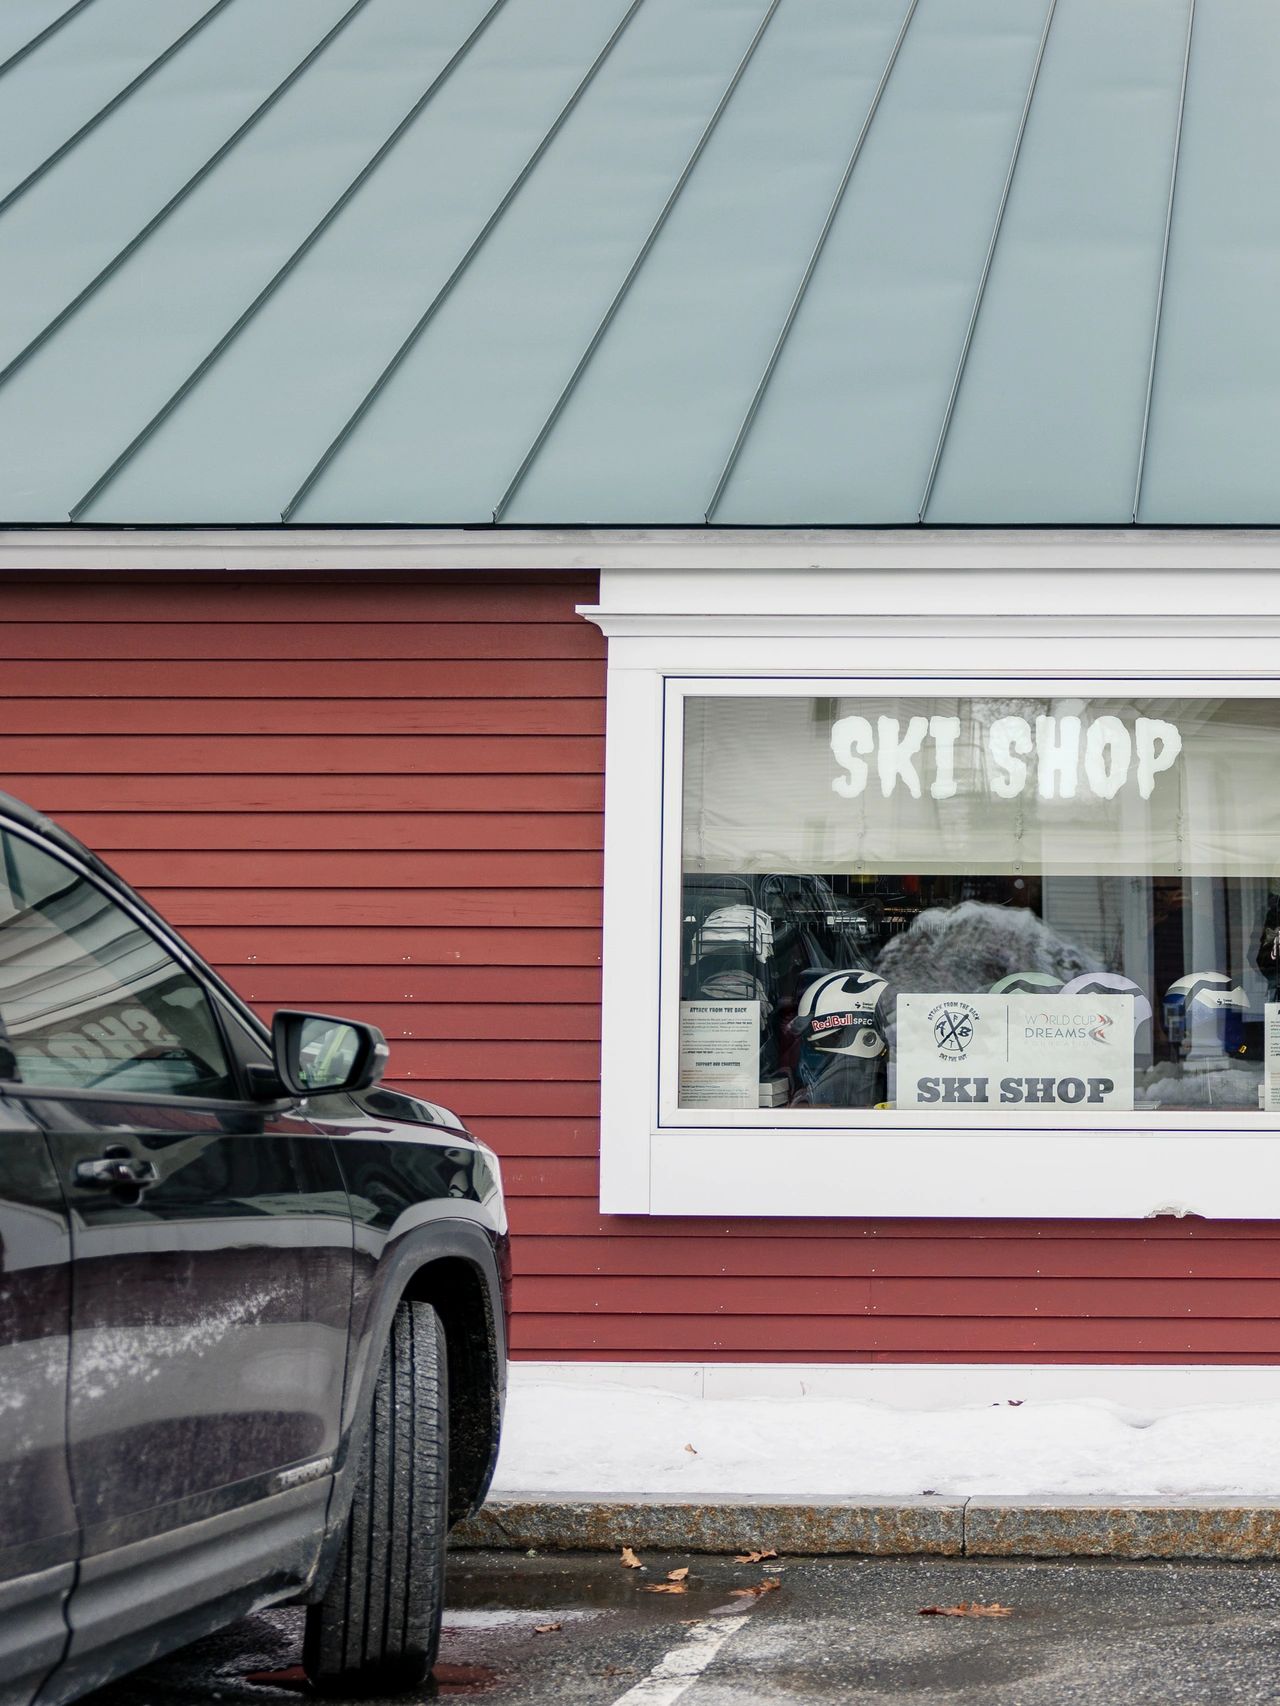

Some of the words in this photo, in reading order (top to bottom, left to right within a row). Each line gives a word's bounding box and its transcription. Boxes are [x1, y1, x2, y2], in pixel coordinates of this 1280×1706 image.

[830, 715, 961, 800] SKI
[988, 714, 1183, 800] SHOP
[959, 1002, 970, 1010] THE
[812, 1016, 832, 1031] Red
[831, 1014, 853, 1027] Bull
[1025, 1013, 1070, 1025] WORLD
[1072, 1014, 1097, 1025] CUP
[1024, 1027, 1086, 1038] DREAMS
[917, 1077, 989, 1103] SKI
[1000, 1077, 1114, 1104] SHOP
